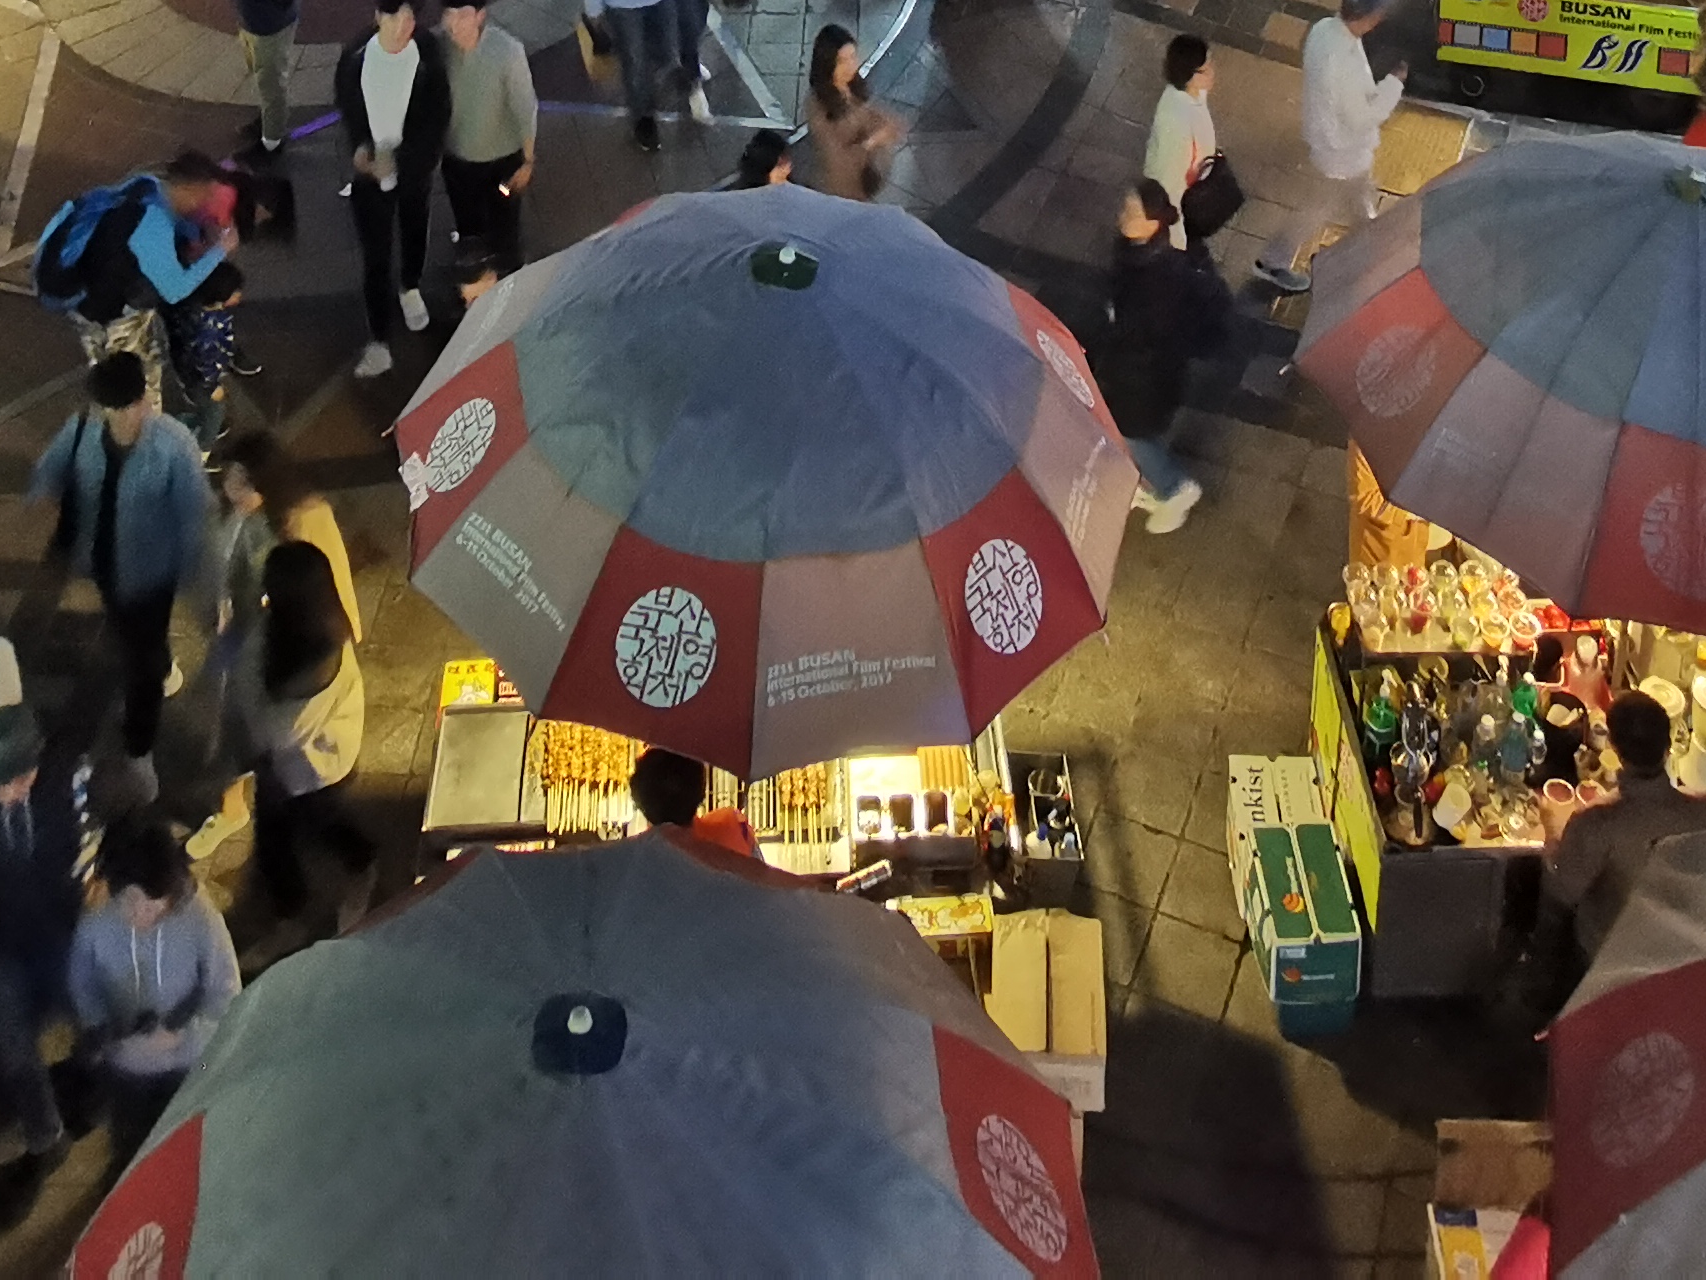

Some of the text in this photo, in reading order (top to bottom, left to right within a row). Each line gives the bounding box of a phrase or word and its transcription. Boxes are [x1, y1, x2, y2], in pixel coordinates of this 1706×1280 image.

[1559, 0, 1632, 21] BUSAN
[1558, 12, 1635, 36] International
[1638, 22, 1665, 38] Film
[492, 528, 532, 572] BUSAN
[798, 648, 856, 671] BUSAN
[767, 654, 937, 693] International Film Festival
